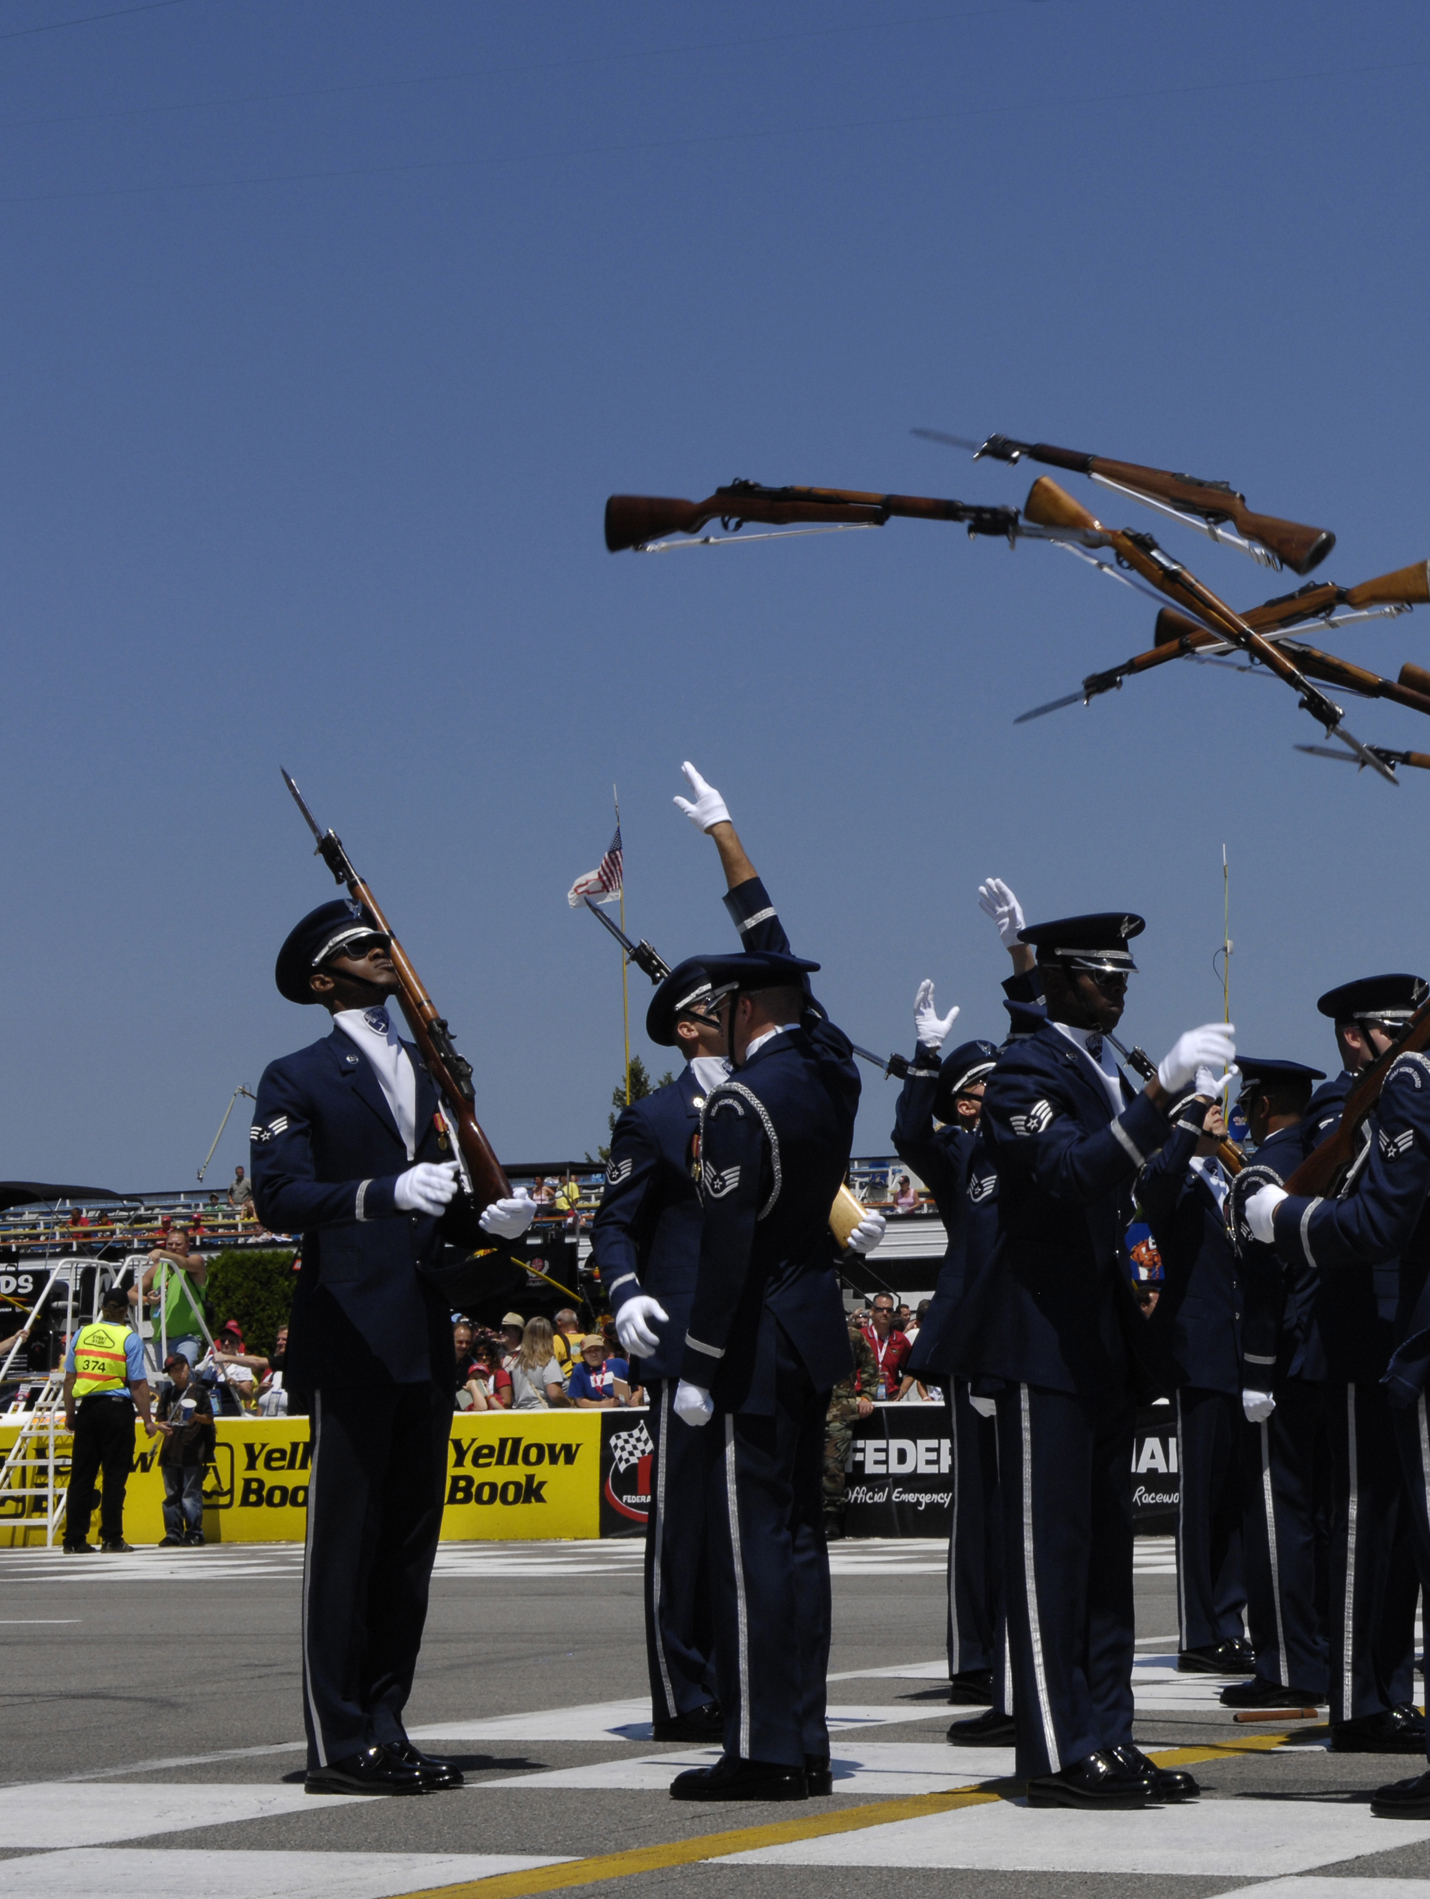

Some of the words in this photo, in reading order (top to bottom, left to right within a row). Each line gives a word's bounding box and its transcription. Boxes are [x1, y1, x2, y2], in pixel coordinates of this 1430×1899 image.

[82, 1359, 106, 1373] 374
[242, 1441, 311, 1471] Yell
[449, 1436, 584, 1469] Yellow
[237, 1477, 309, 1508] Boo
[444, 1473, 548, 1507] Book
[622, 1494, 651, 1503] FEDERA
[892, 1488, 952, 1511] Emergency
[1133, 1485, 1179, 1507] Racewa
